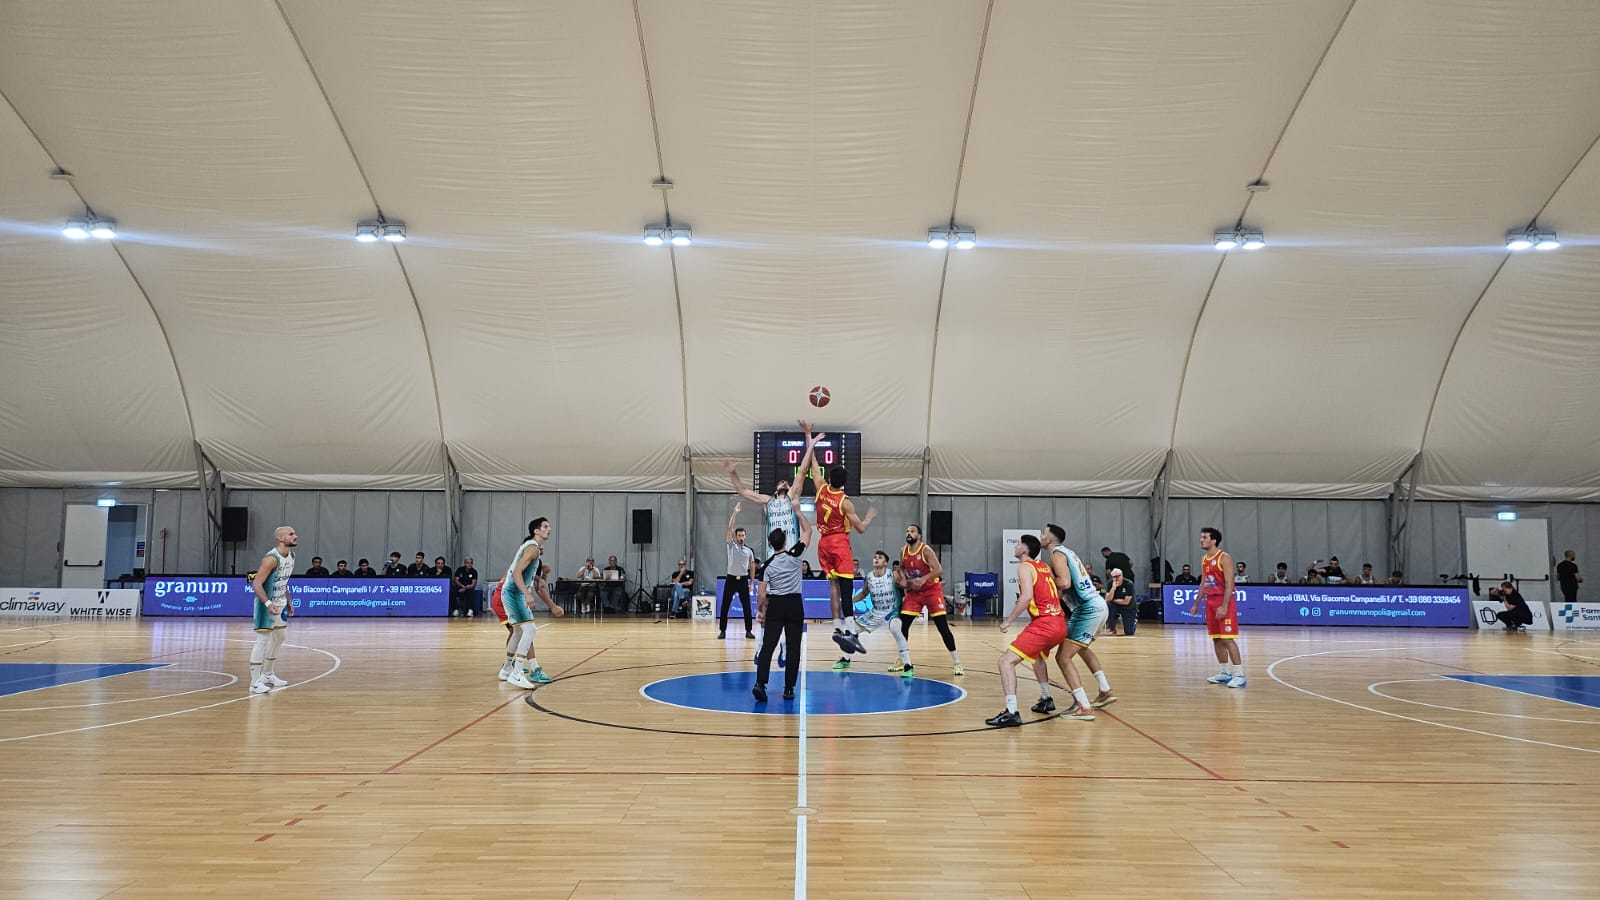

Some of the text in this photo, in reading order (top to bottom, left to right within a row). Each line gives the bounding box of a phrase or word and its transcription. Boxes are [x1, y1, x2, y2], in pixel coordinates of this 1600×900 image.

[825, 450, 833, 464] 0
[822, 503, 832, 524] 7
[154, 581, 228, 597] granum
[292, 585, 302, 593] Via
[303, 585, 331, 593] Giacomo
[332, 585, 367, 595] Campanelli
[0, 597, 66, 613] climaway
[309, 599, 406, 607] granummonopoli@gmail.com
[1263, 594, 1292, 603] Monopoli
[1310, 594, 1320, 602] Via
[1321, 594, 1350, 602] Giacomo
[1350, 595, 1386, 604] Campanelli
[70, 607, 132, 616] WHITE WISE
